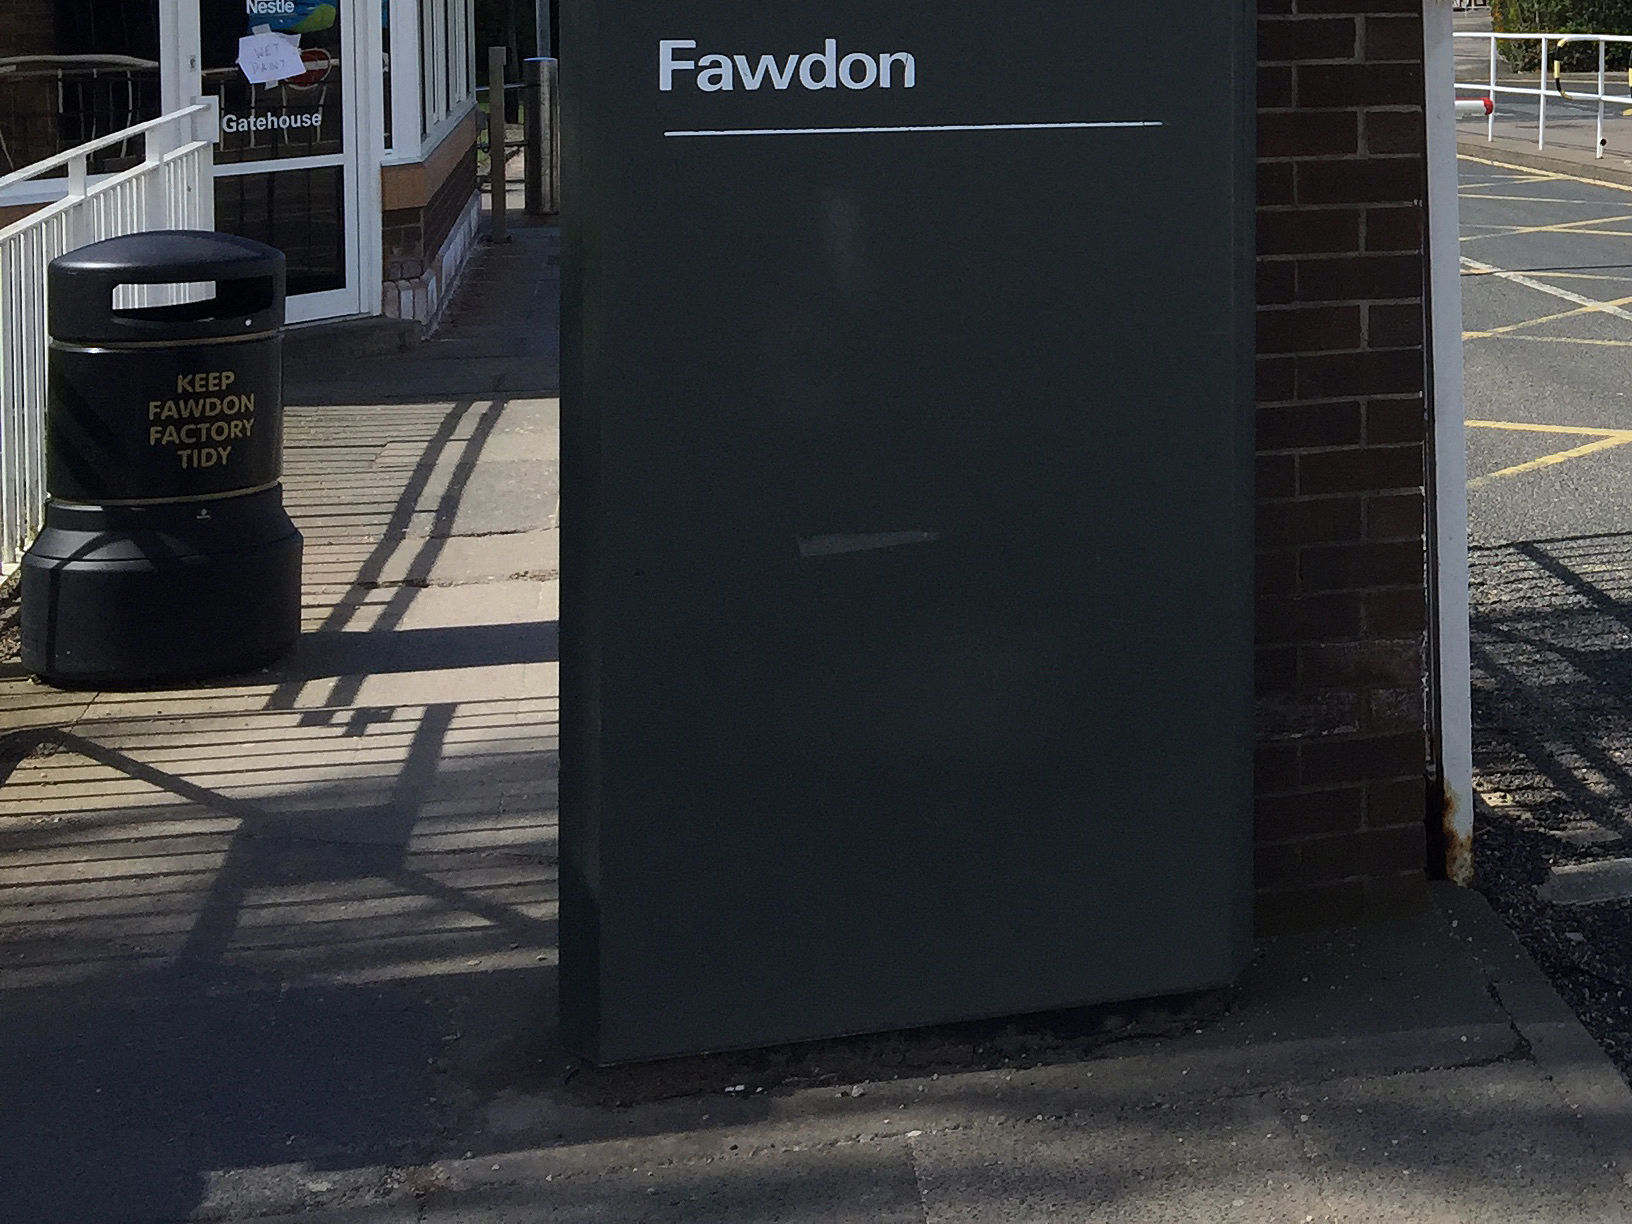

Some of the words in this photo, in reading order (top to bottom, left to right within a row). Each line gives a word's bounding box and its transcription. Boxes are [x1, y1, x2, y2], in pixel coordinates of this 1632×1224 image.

[659, 38, 915, 92] Fawdon
[222, 112, 321, 132] Gatehouse
[177, 371, 235, 393] KEEP
[149, 393, 255, 420] FAWDON
[149, 417, 255, 446] FACTORY
[177, 446, 232, 469] TIDY
